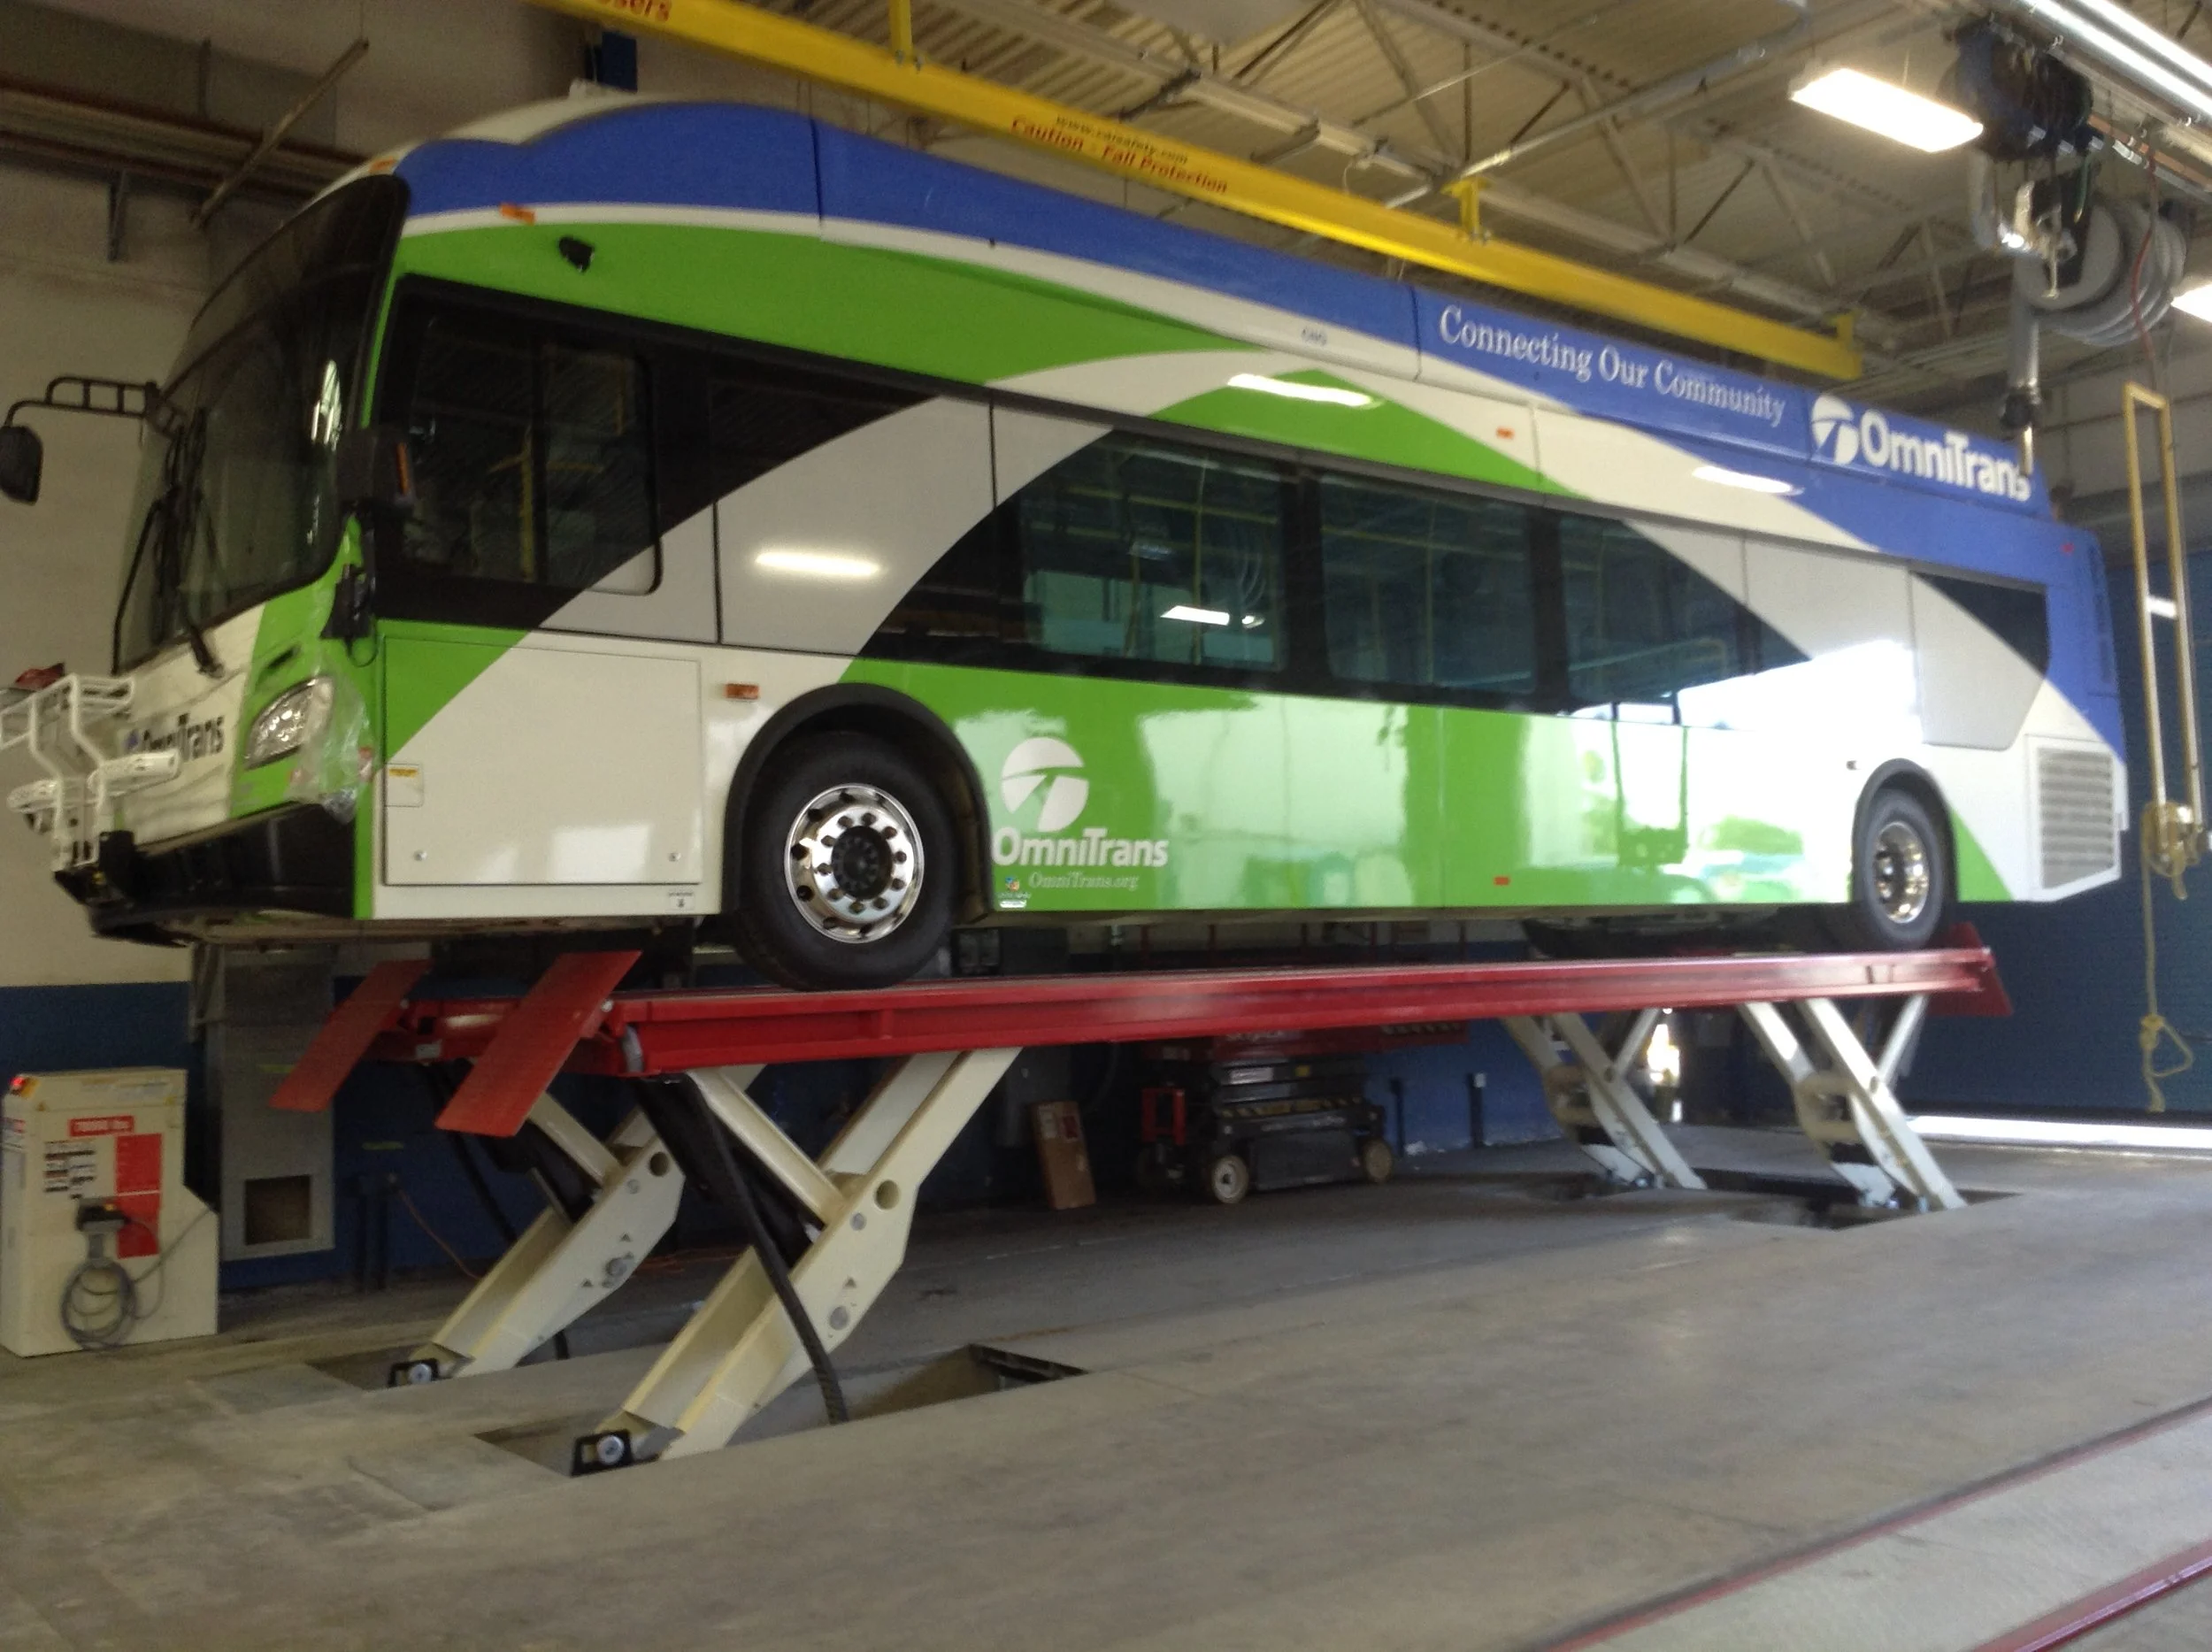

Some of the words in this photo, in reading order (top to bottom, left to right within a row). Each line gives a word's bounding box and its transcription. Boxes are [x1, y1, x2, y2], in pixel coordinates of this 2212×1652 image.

[1011, 118, 1084, 151] Caution
[1102, 144, 1137, 167] Fall
[1140, 155, 1228, 194] Protection
[1440, 304, 1594, 382] Connecting
[1599, 344, 1650, 388] Our
[1654, 358, 1786, 427] Community
[1860, 409, 2032, 502] OmniTrans
[990, 826, 1170, 868] OmniTrans
[1029, 872, 1139, 891] OmniTrans.org
